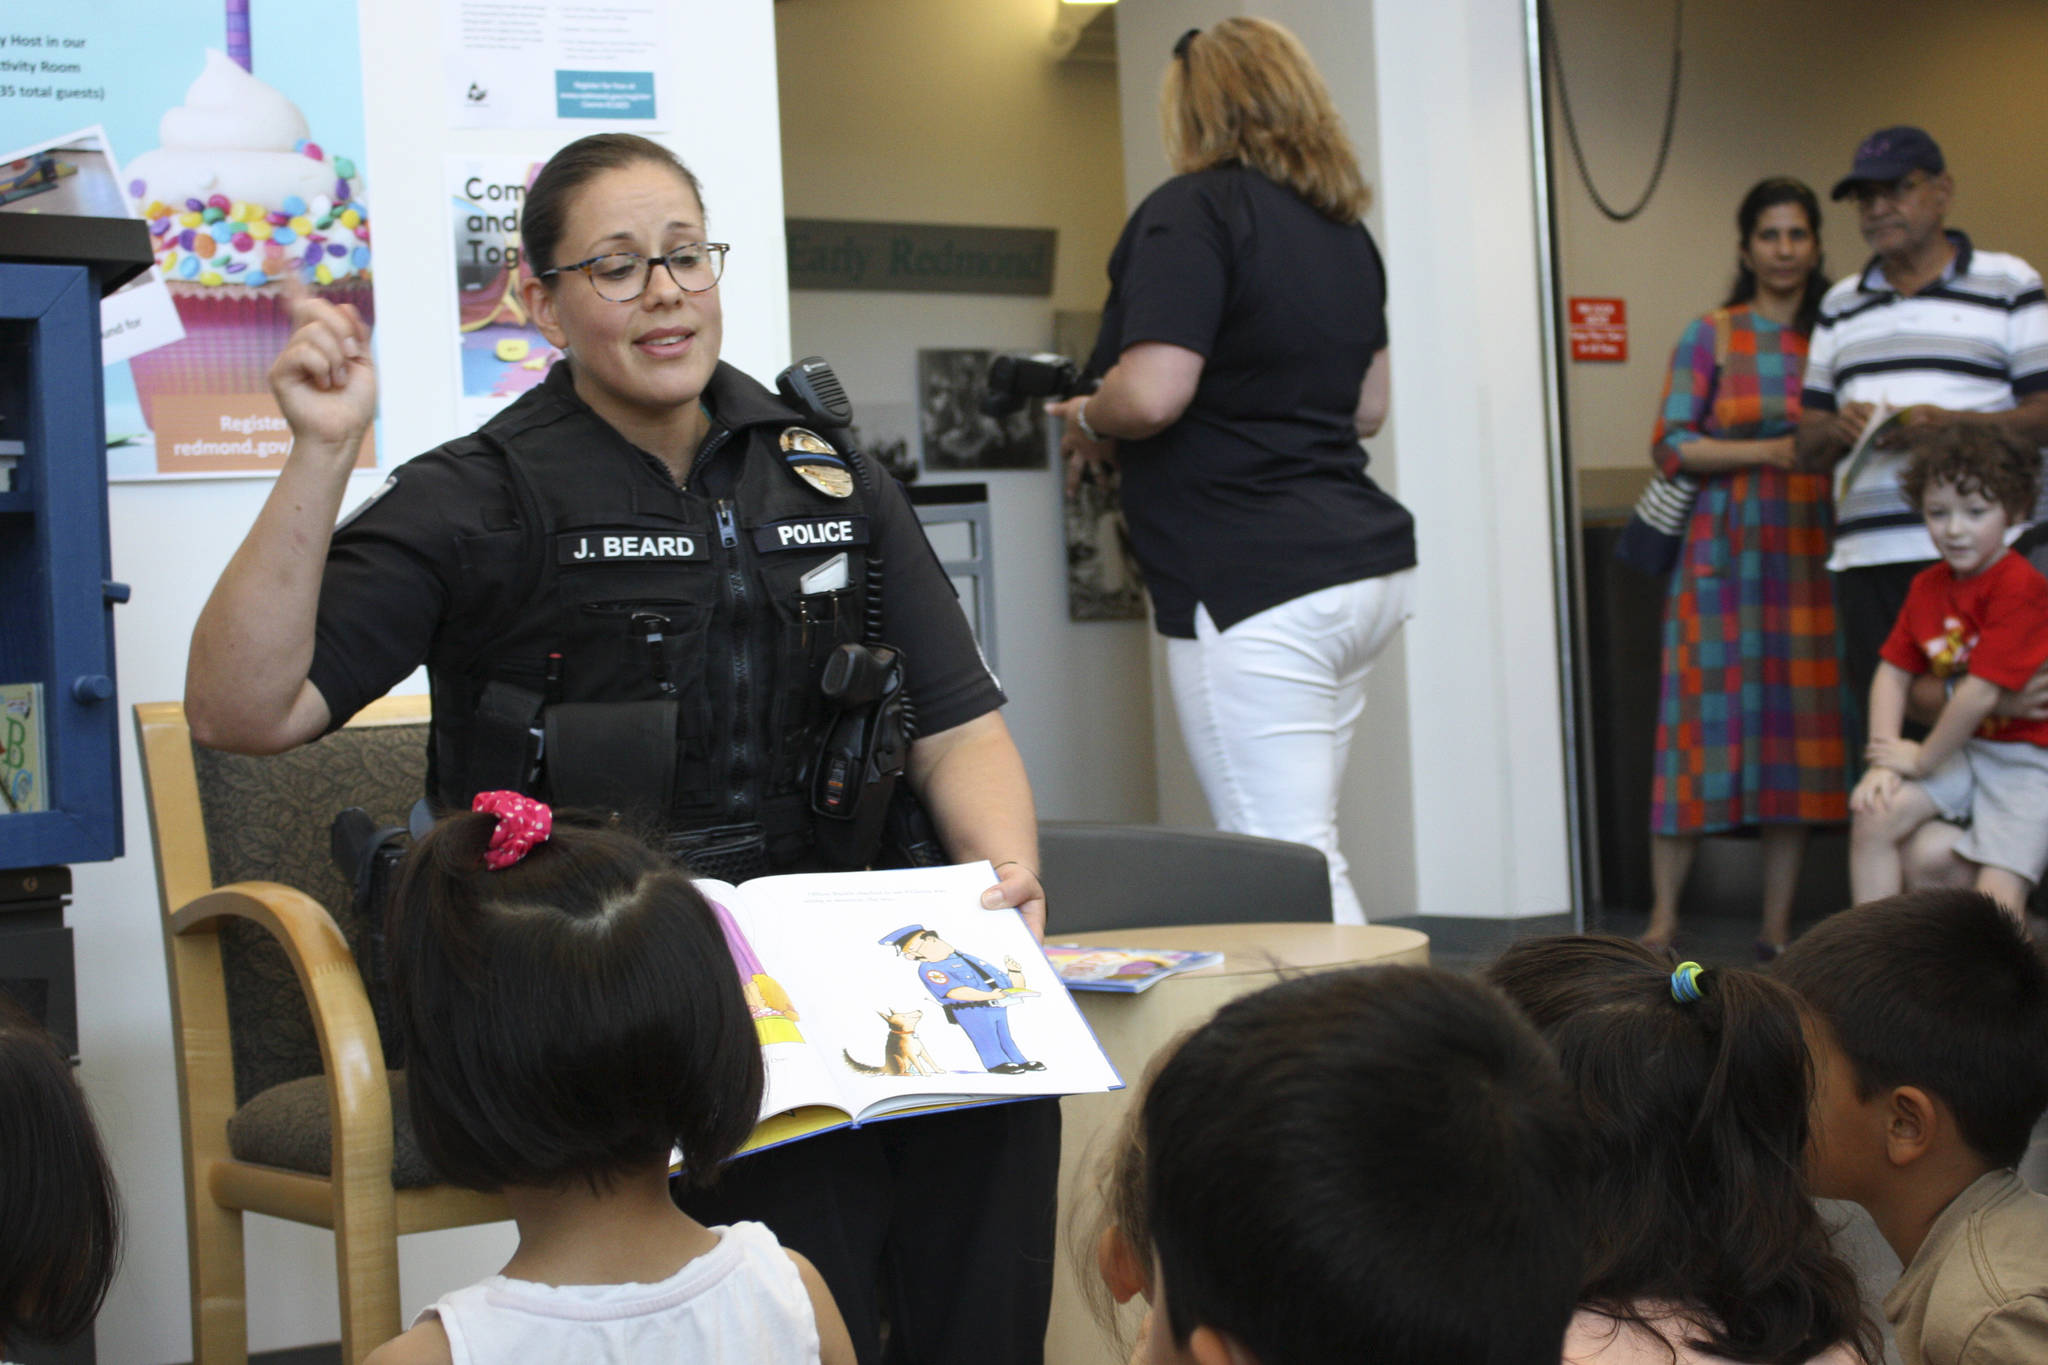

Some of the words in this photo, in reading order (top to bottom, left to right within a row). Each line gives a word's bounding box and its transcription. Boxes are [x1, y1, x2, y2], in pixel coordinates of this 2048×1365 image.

[11, 35, 42, 48] Host
[46, 35, 59, 48] in
[62, 38, 86, 49] our
[41, 61, 81, 73] Room
[0, 85, 16, 97] 35
[20, 86, 53, 97] total
[56, 87, 104, 102] guests)
[466, 208, 519, 233] and
[466, 239, 519, 270] Tog
[777, 520, 853, 546] POLICE
[573, 537, 596, 560] J.
[603, 536, 695, 558] BEARD
